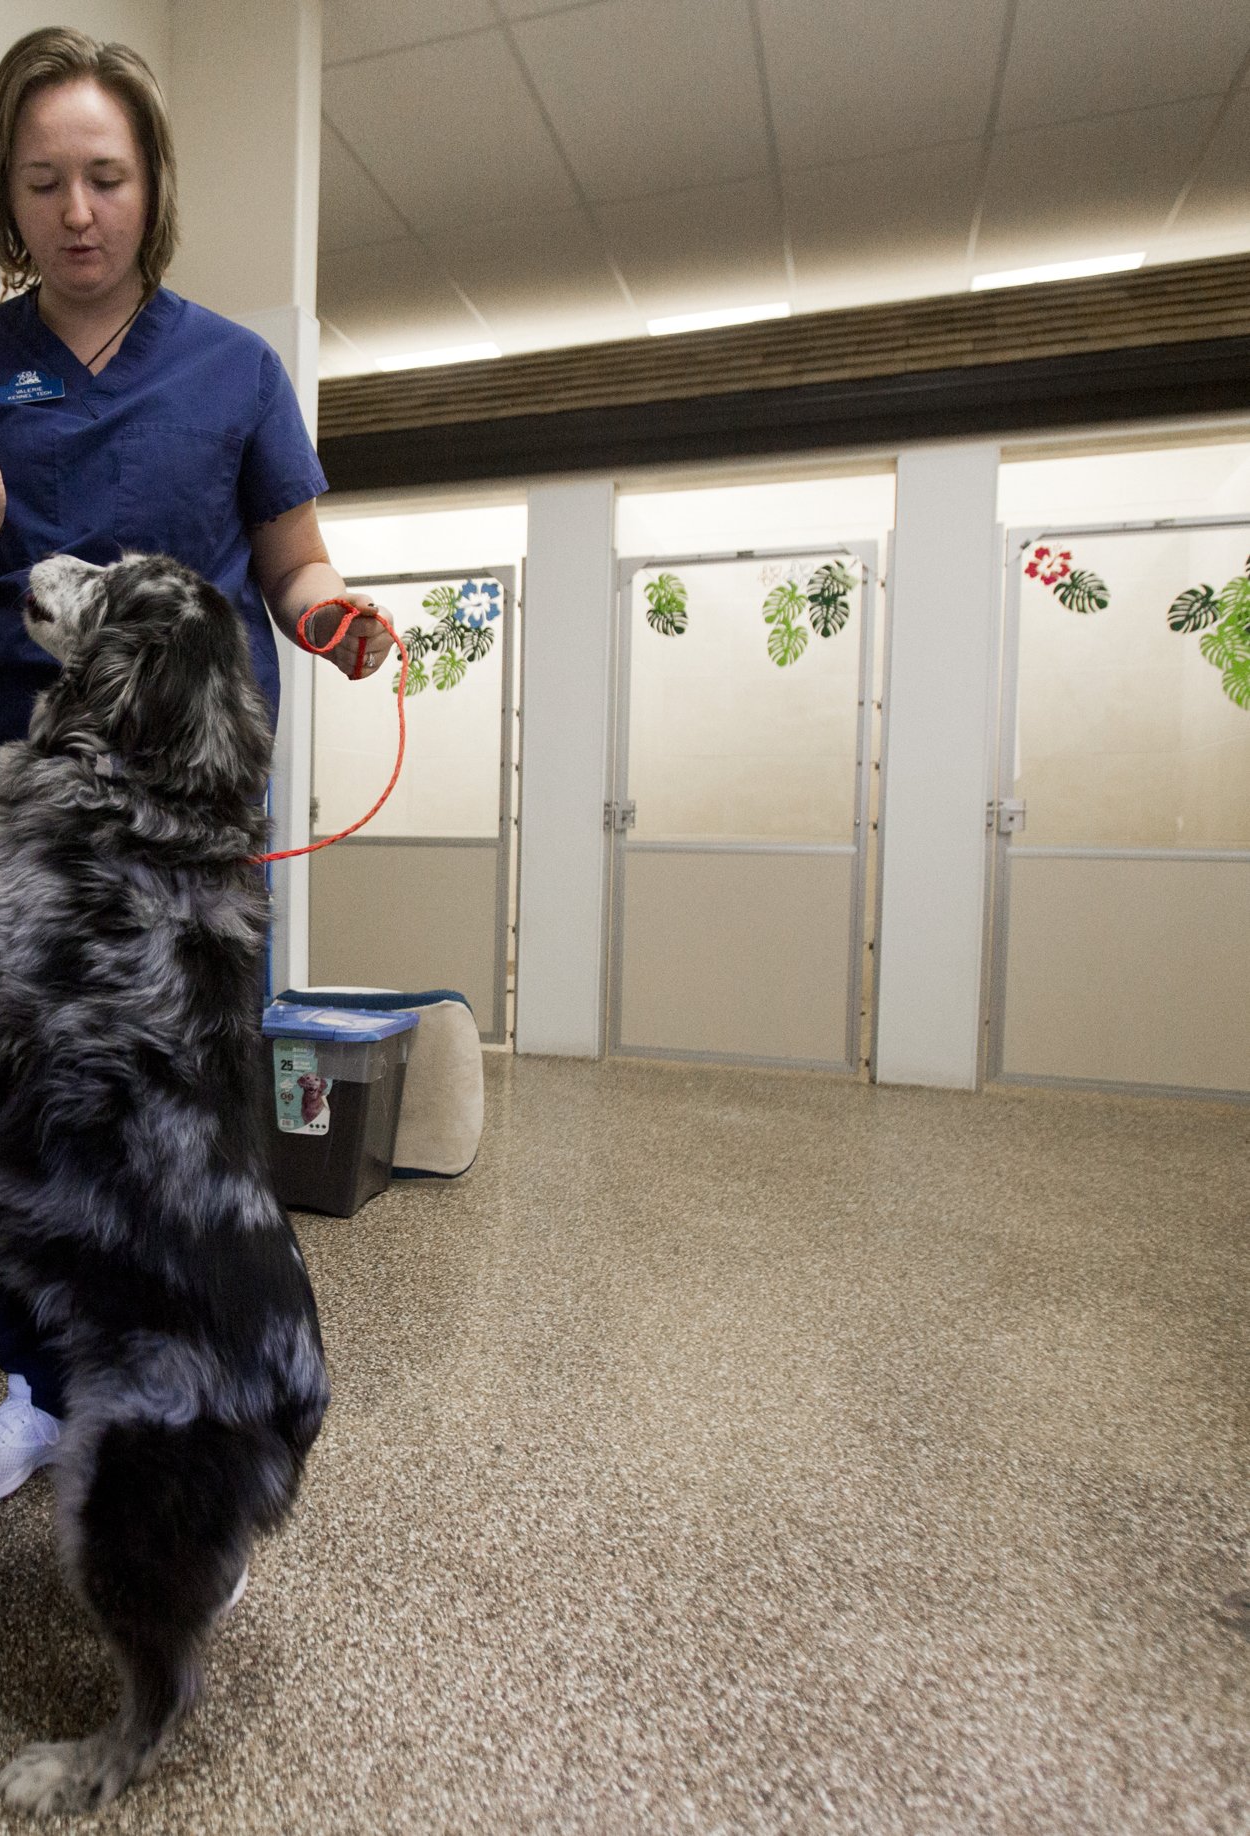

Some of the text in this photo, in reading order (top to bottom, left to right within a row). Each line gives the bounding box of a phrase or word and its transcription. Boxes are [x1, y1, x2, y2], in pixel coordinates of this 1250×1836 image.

[15, 386, 43, 395] VALERIE
[7, 393, 33, 401] KENNEL
[280, 1059, 293, 1071] 25
